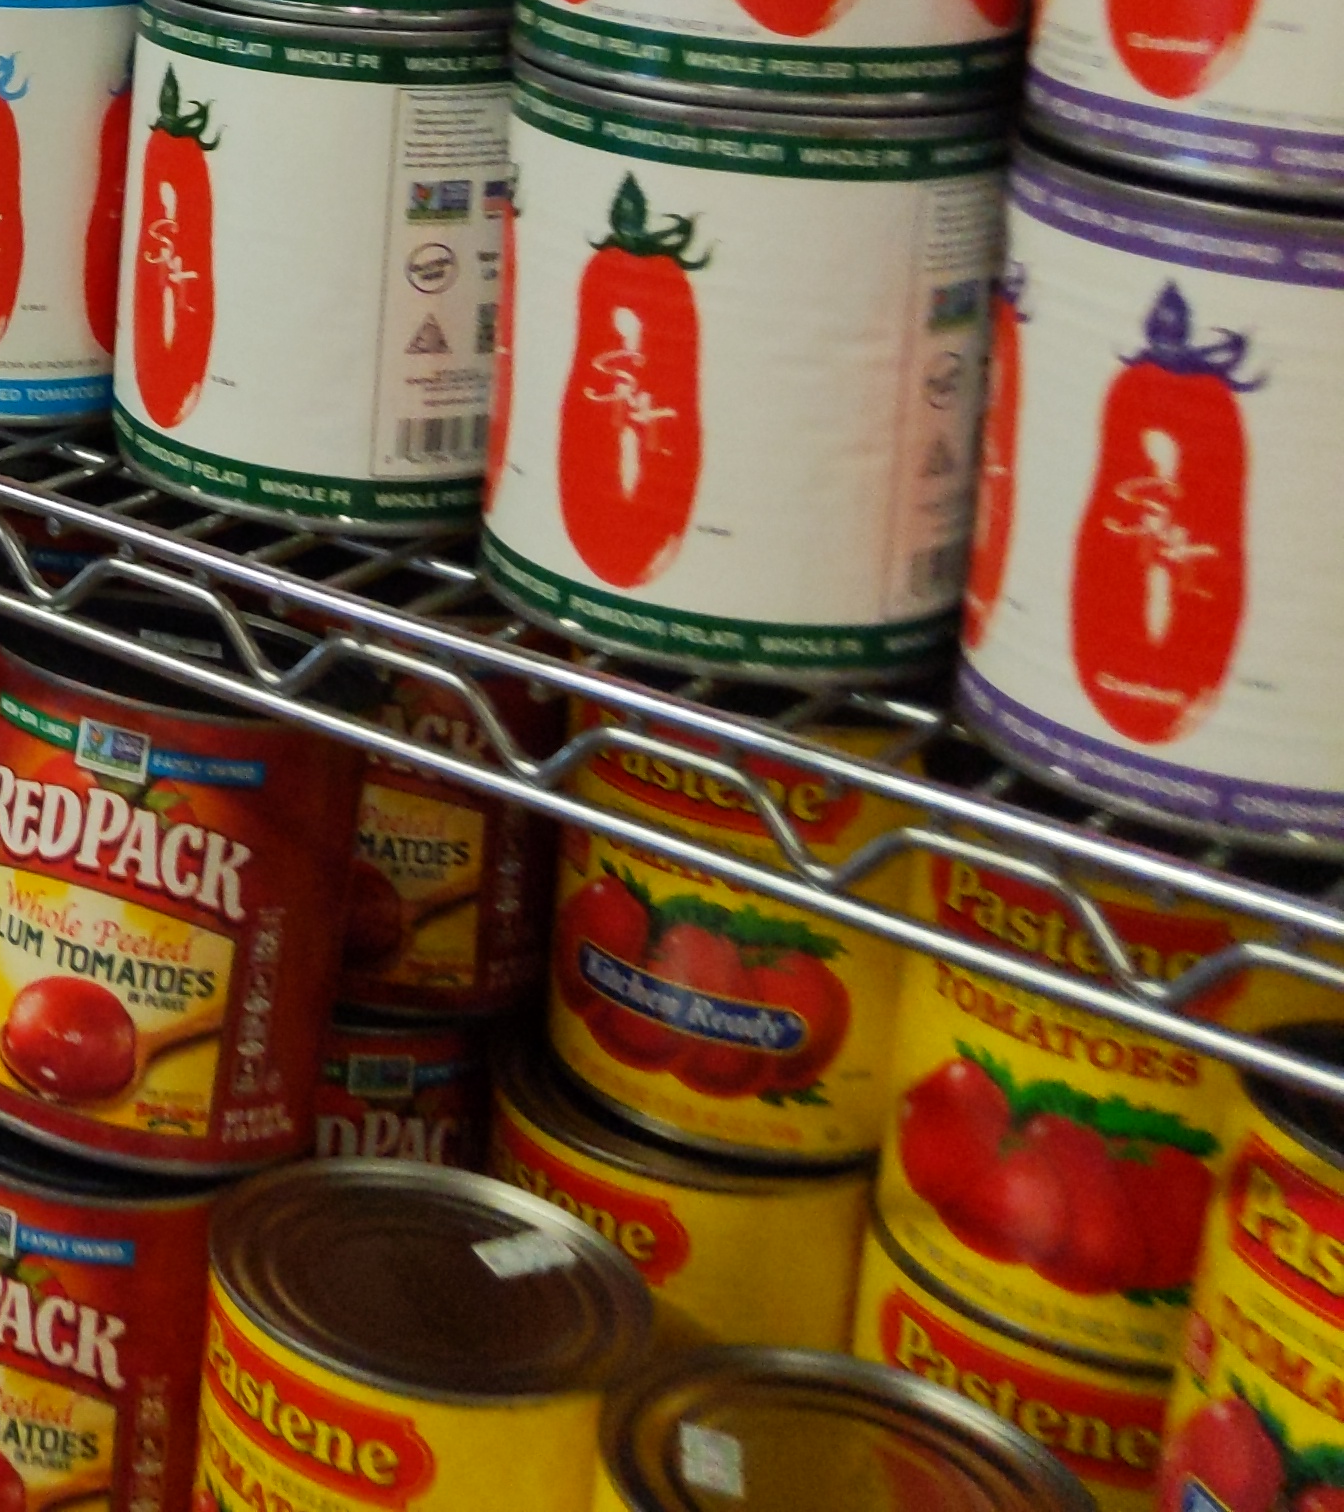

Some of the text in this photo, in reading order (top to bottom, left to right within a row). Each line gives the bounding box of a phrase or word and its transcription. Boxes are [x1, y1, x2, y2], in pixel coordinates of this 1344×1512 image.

[684, 49, 762, 73] WHOLE
[7, 882, 193, 965] Whole Peeled
[54, 934, 216, 999] TOMATOES
[936, 964, 1201, 1086] TOMATOES
